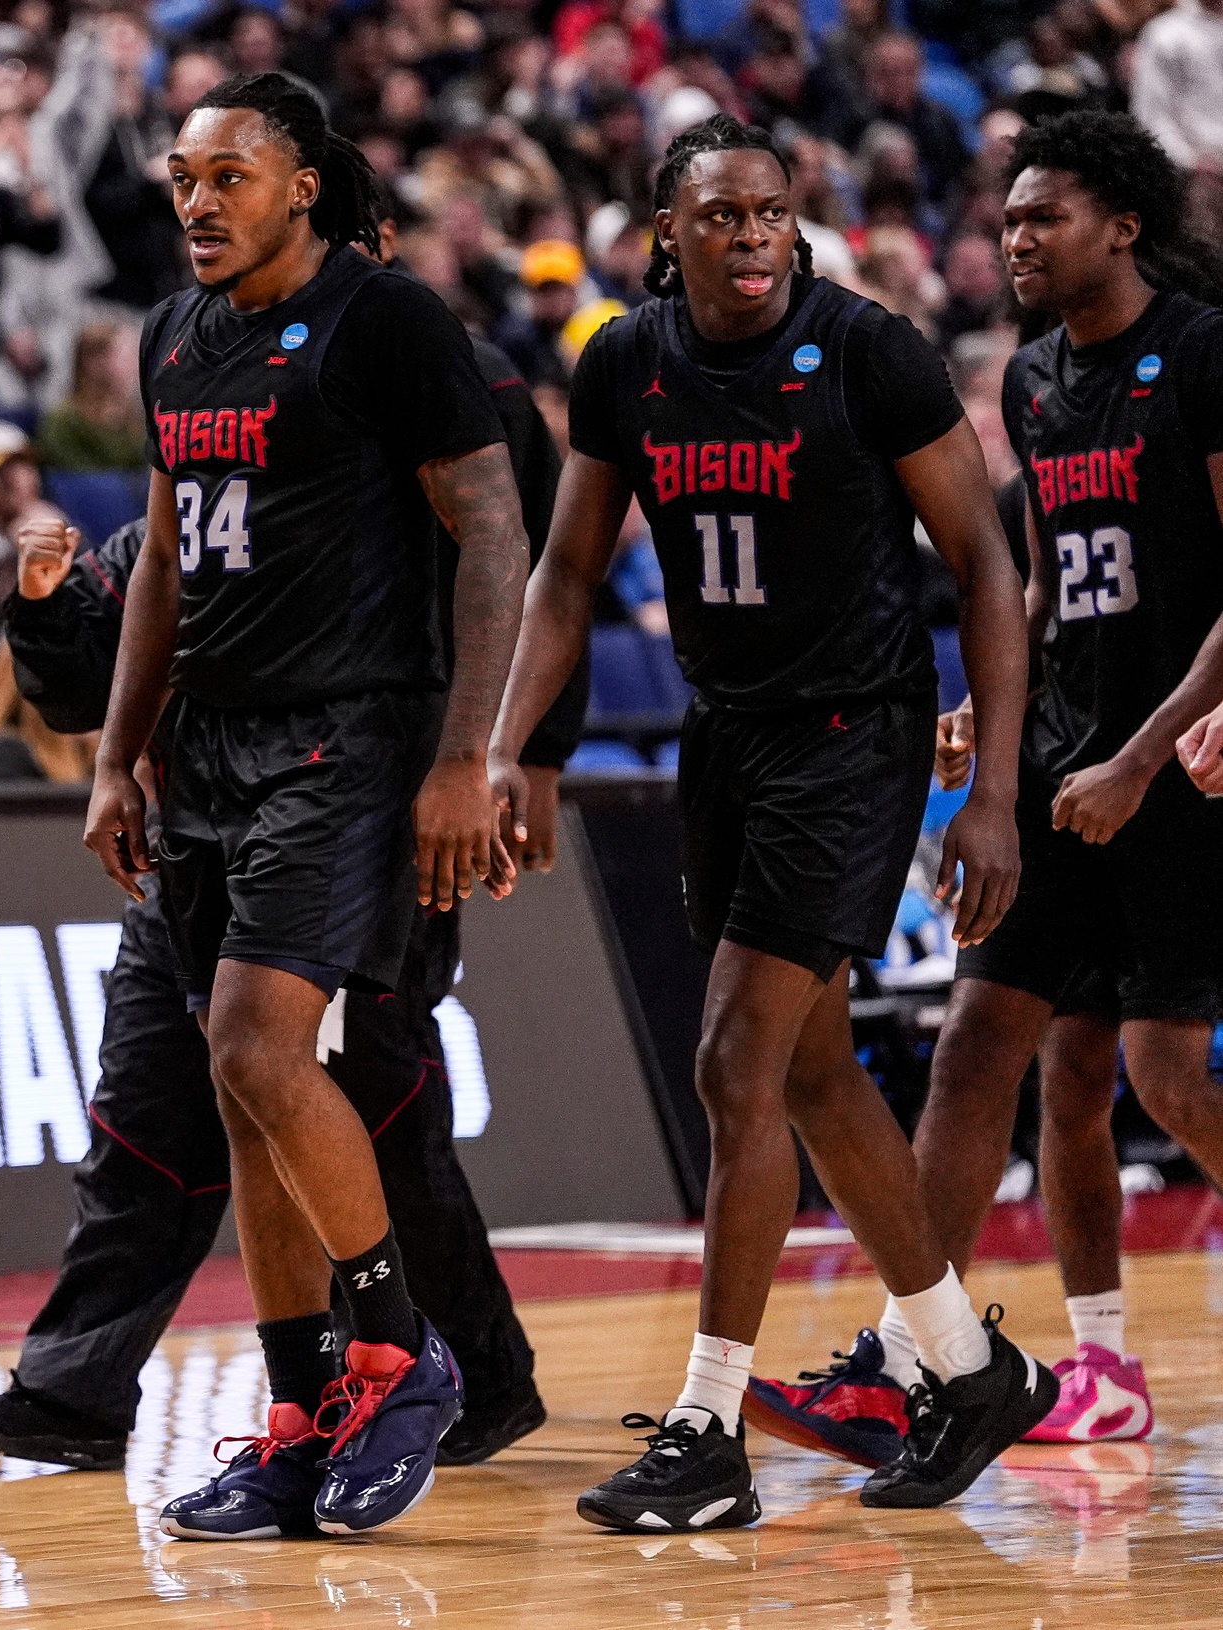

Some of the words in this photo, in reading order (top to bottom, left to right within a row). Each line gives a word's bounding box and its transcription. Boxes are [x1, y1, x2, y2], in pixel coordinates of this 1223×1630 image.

[154, 395, 277, 473] BISON
[643, 428, 802, 504] BISON
[1030, 434, 1144, 515] BISON
[175, 477, 252, 574] 34
[693, 512, 767, 606] 11
[1055, 525, 1139, 622] 23
[352, 1260, 391, 1289] 23
